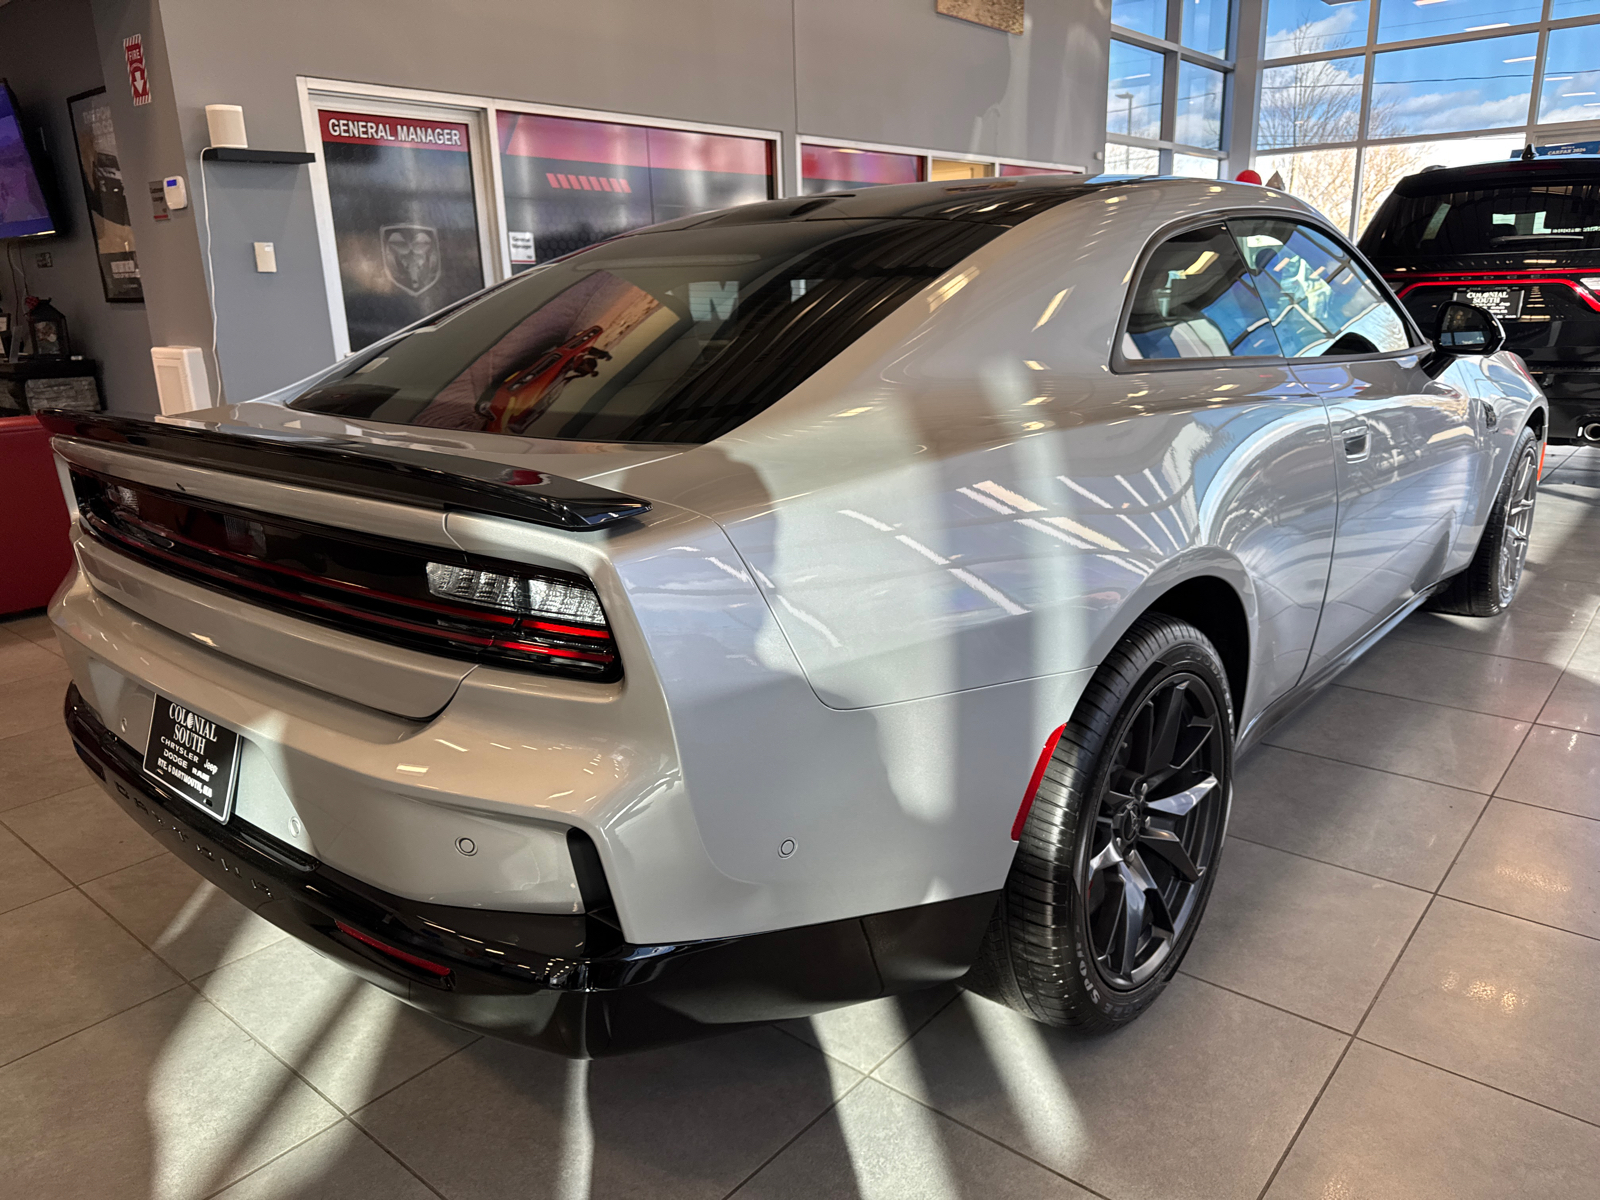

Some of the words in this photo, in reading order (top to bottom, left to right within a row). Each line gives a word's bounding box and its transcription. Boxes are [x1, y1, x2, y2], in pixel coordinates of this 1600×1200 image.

[128, 49, 141, 61] FIRE
[328, 118, 395, 141] GENERAL
[397, 125, 462, 146] MANAGER
[1547, 148, 1572, 156] CARFAX
[168, 702, 218, 742] COLONIAL
[173, 723, 207, 755] SOUTH
[160, 735, 199, 763] CHRYSLER
[163, 748, 189, 769] DODGE
[191, 766, 211, 782] RAM
[203, 758, 219, 775] Jeep
[202, 784, 213, 798] MA
